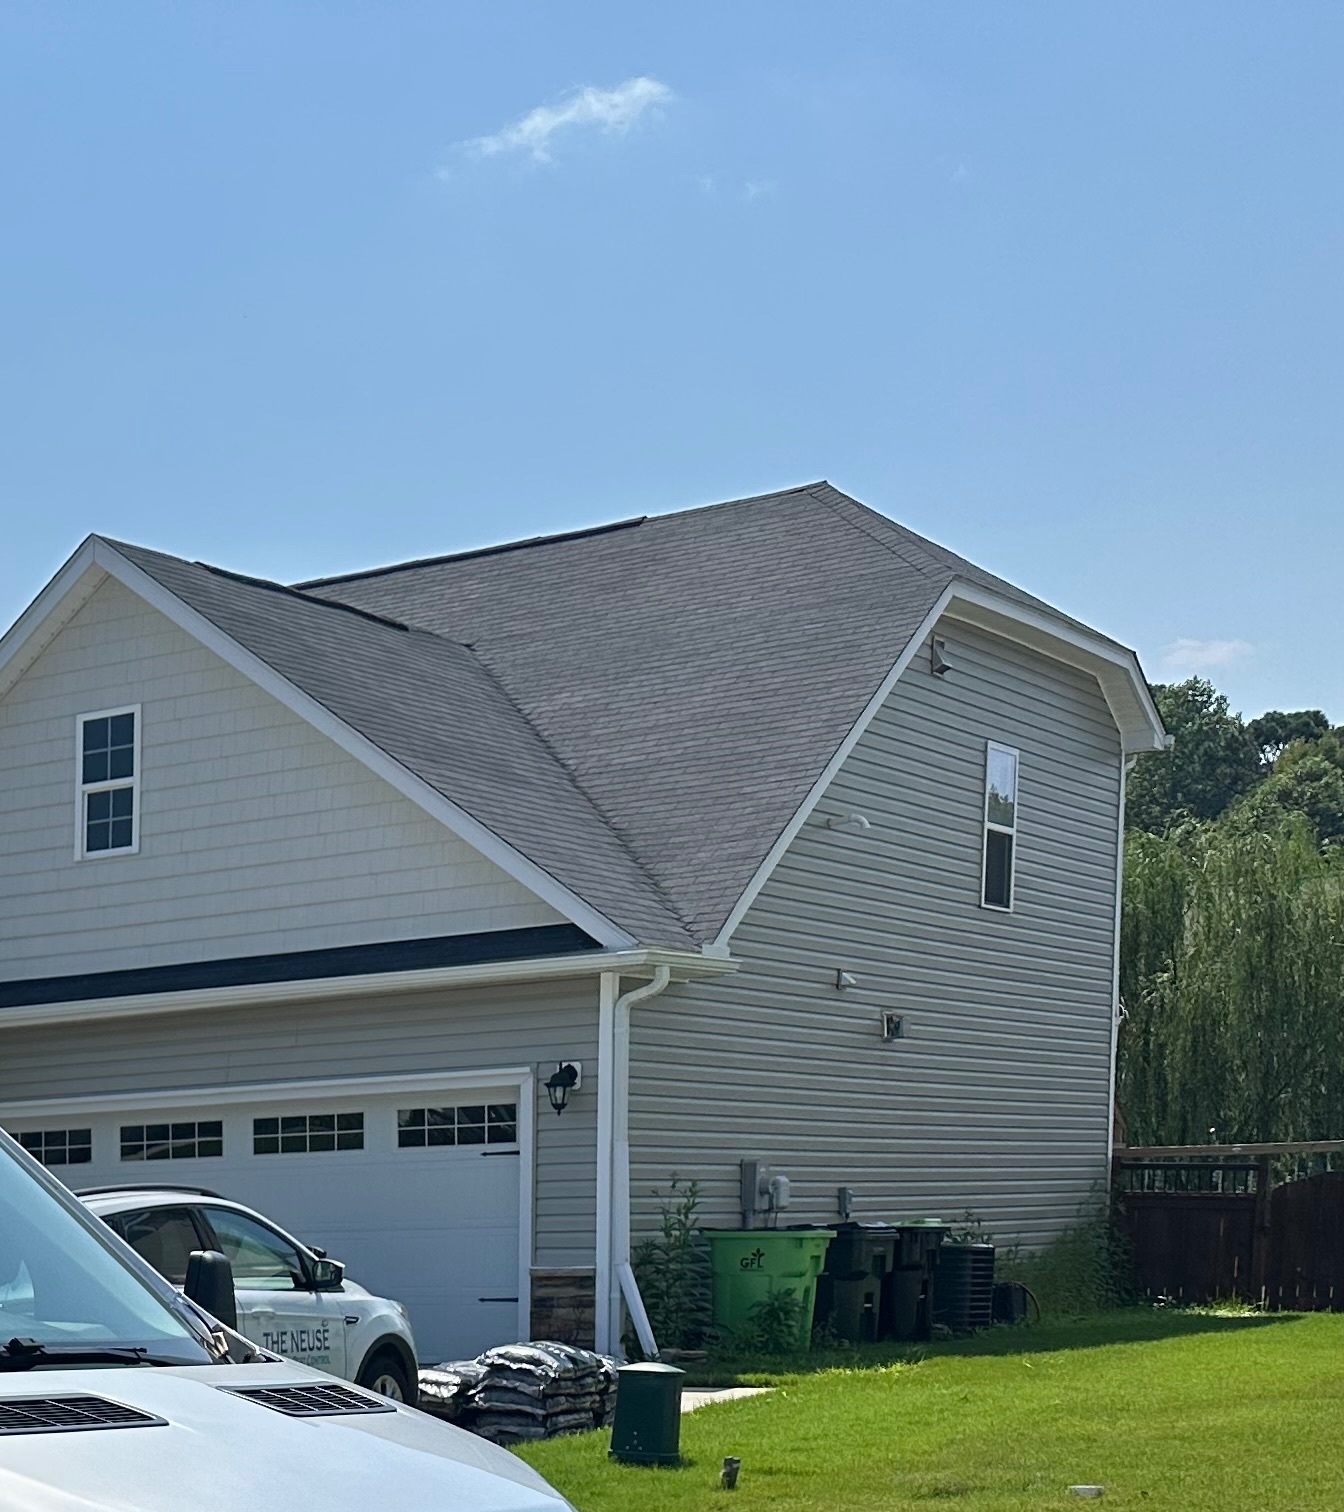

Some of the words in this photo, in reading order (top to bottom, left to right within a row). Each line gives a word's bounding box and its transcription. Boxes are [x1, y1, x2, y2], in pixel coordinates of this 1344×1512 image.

[740, 1251, 765, 1269] GFL
[263, 1331, 288, 1353] THE
[290, 1329, 330, 1353] NEUSE
